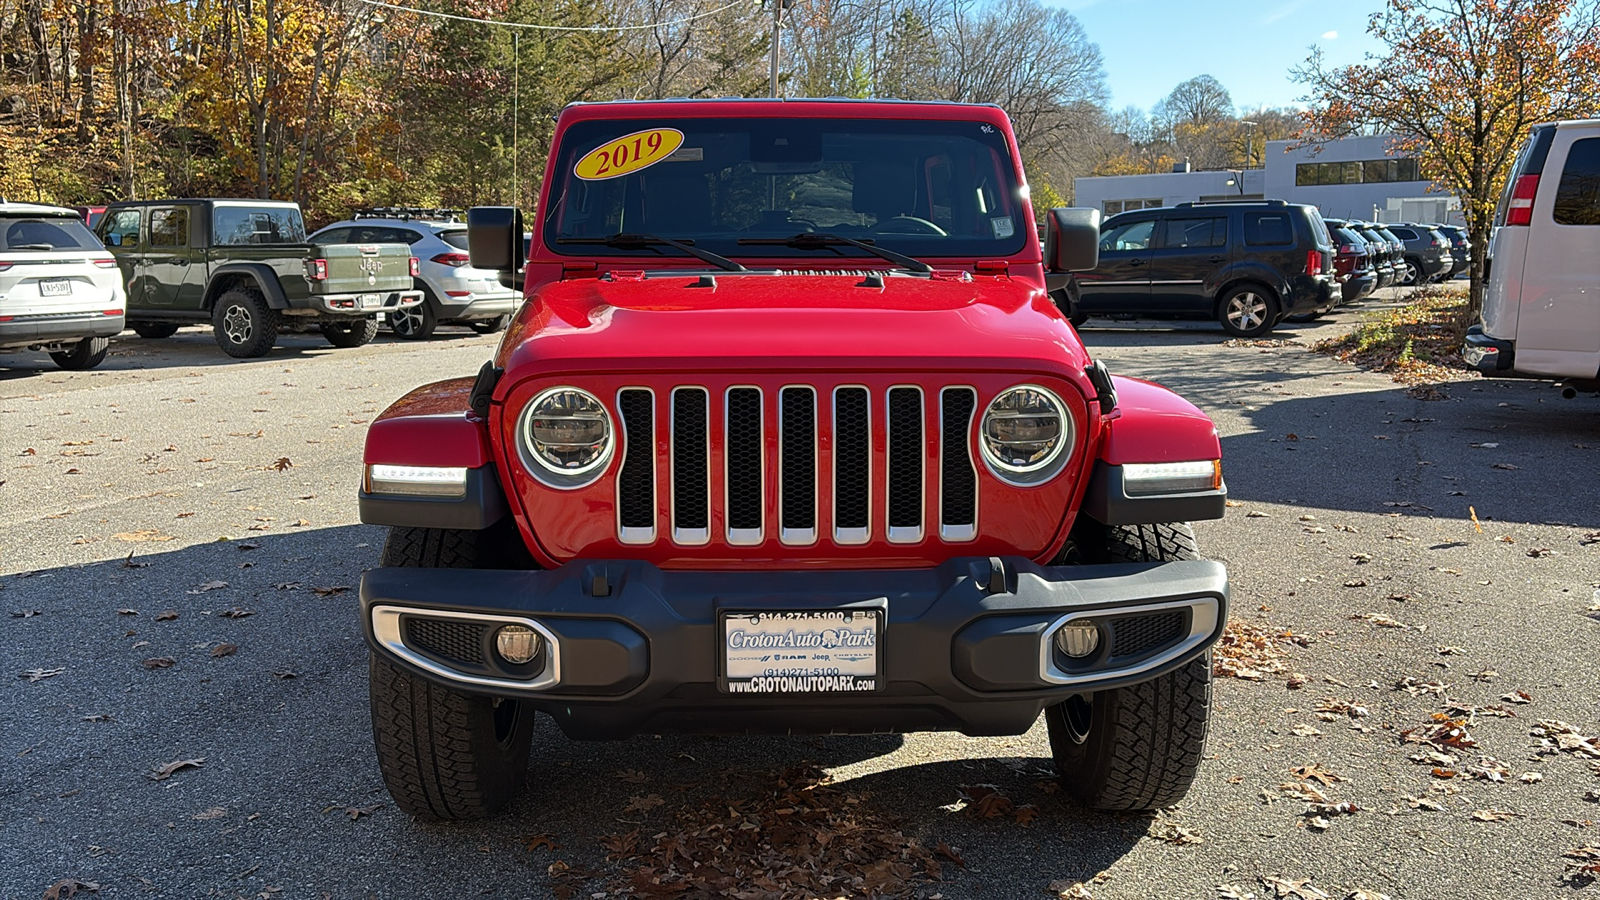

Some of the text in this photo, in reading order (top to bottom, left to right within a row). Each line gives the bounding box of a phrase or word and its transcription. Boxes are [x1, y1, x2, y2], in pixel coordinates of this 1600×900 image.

[595, 132, 662, 176] 2019
[360, 259, 382, 272] Jeep
[838, 628, 875, 647] Park
